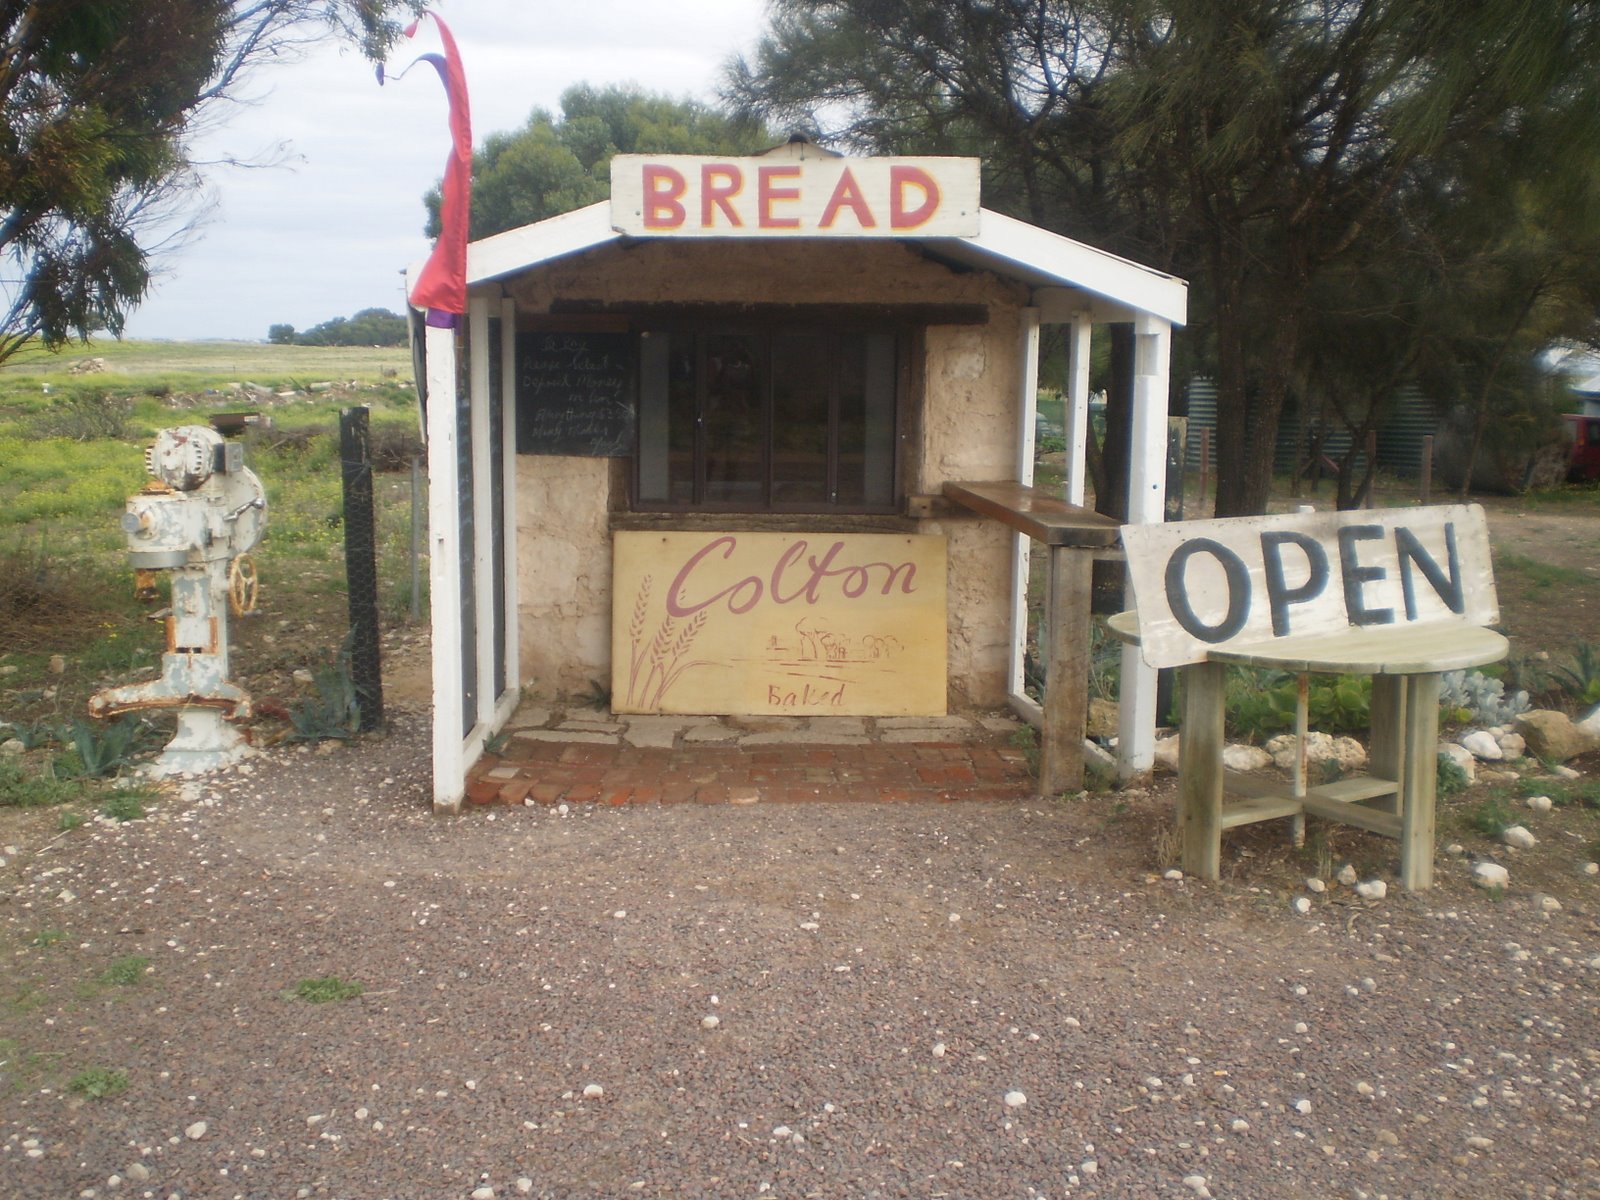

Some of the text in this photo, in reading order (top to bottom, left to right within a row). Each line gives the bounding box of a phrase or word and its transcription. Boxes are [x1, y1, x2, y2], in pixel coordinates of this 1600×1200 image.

[642, 163, 943, 231] BREAD
[666, 536, 918, 618] Colton
[1165, 522, 1465, 644] OPEN
[768, 683, 846, 706] Baked
